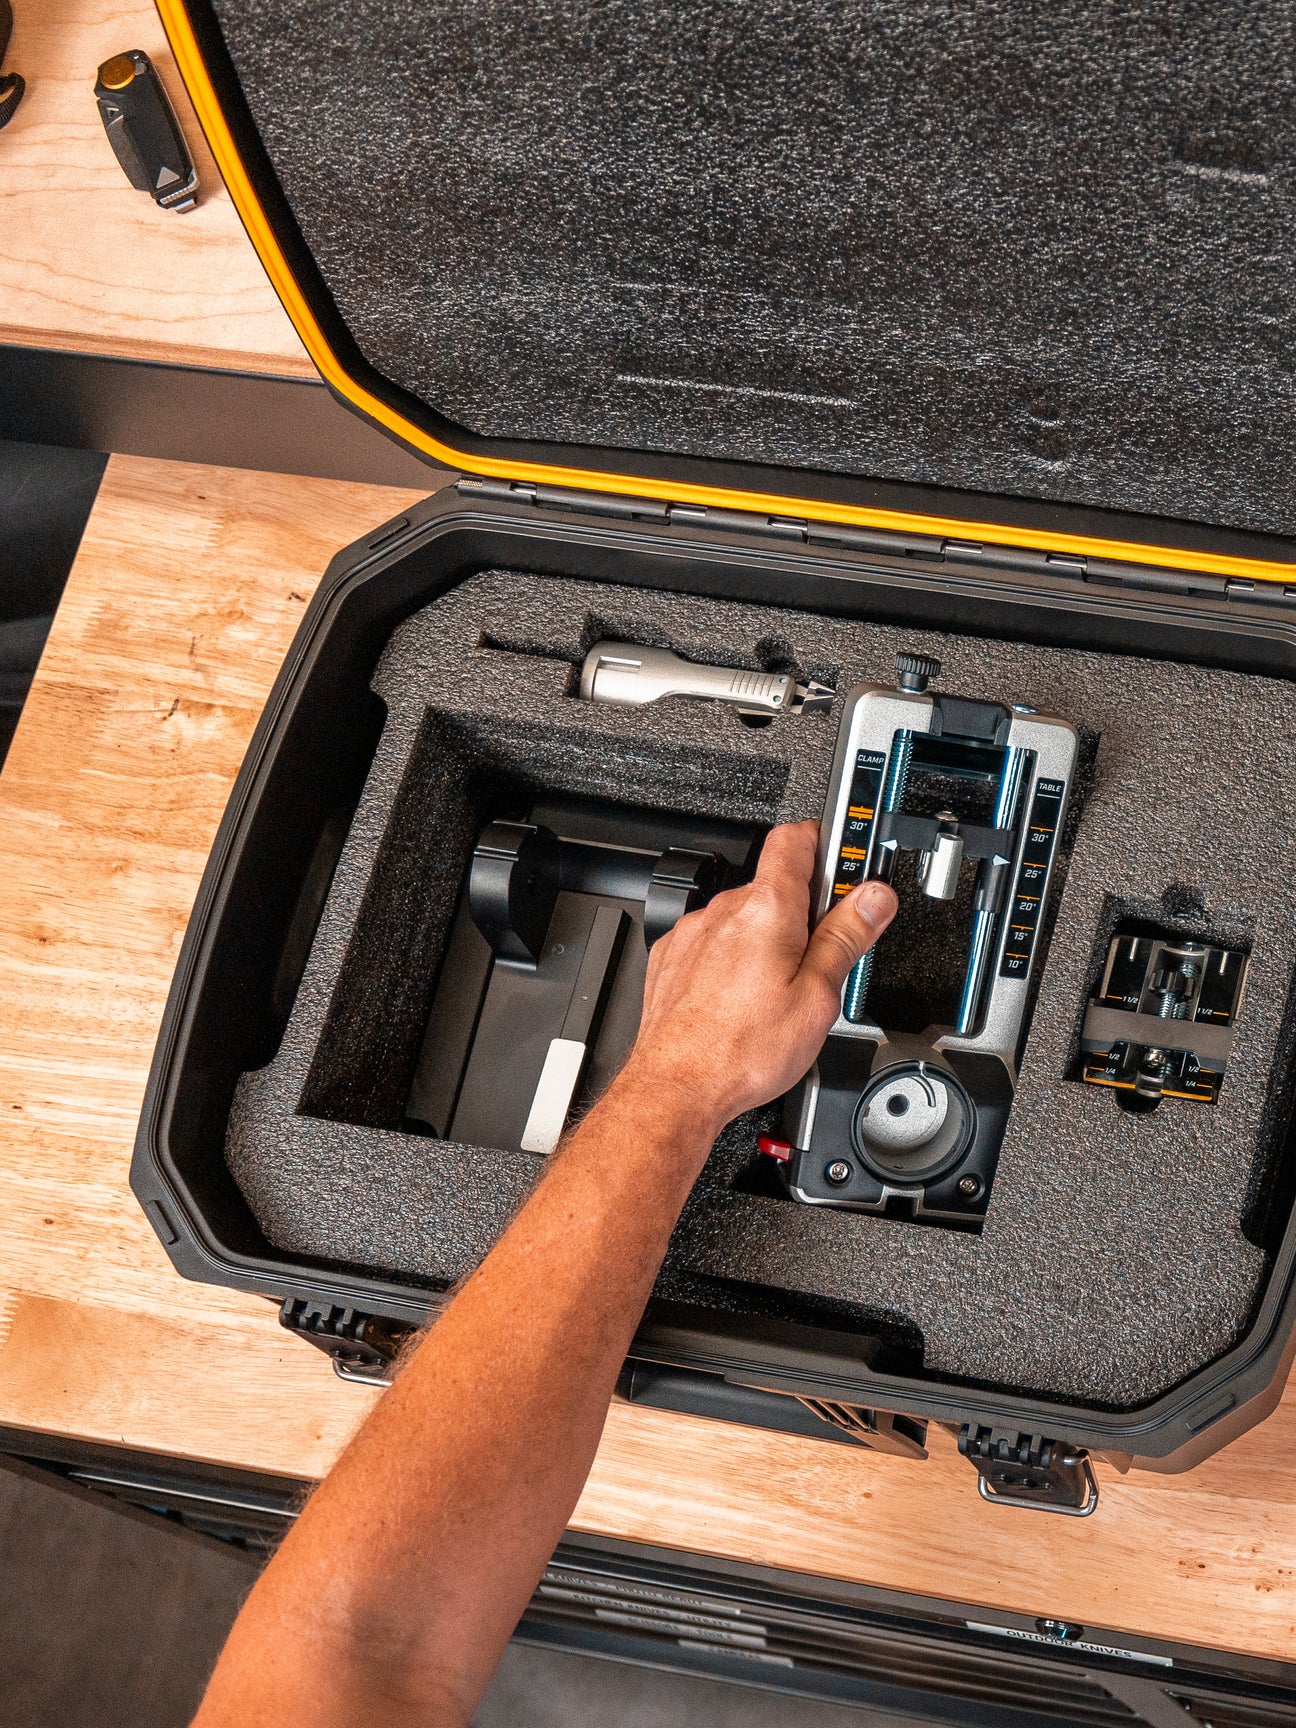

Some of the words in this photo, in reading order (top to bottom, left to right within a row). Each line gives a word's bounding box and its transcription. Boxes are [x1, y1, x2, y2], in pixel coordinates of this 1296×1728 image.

[858, 754, 885, 764] CLAMP
[1039, 782, 1062, 793] TABLE
[850, 821, 868, 831] 30°
[1031, 833, 1049, 843] 30°
[842, 861, 860, 871] 25°
[1025, 869, 1042, 879] 25°
[1019, 902, 1037, 911] 20°
[1014, 931, 1028, 941] 15°
[1008, 959, 1023, 969] 10°
[1108, 1053, 1120, 1061] 1/2
[1105, 1067, 1116, 1075] 1/4
[1188, 1065, 1200, 1073] 1/2
[1185, 1080, 1196, 1088] 1/4
[1006, 1630, 1074, 1647] OUTDOOR
[1080, 1643, 1132, 1658] KNIVES
